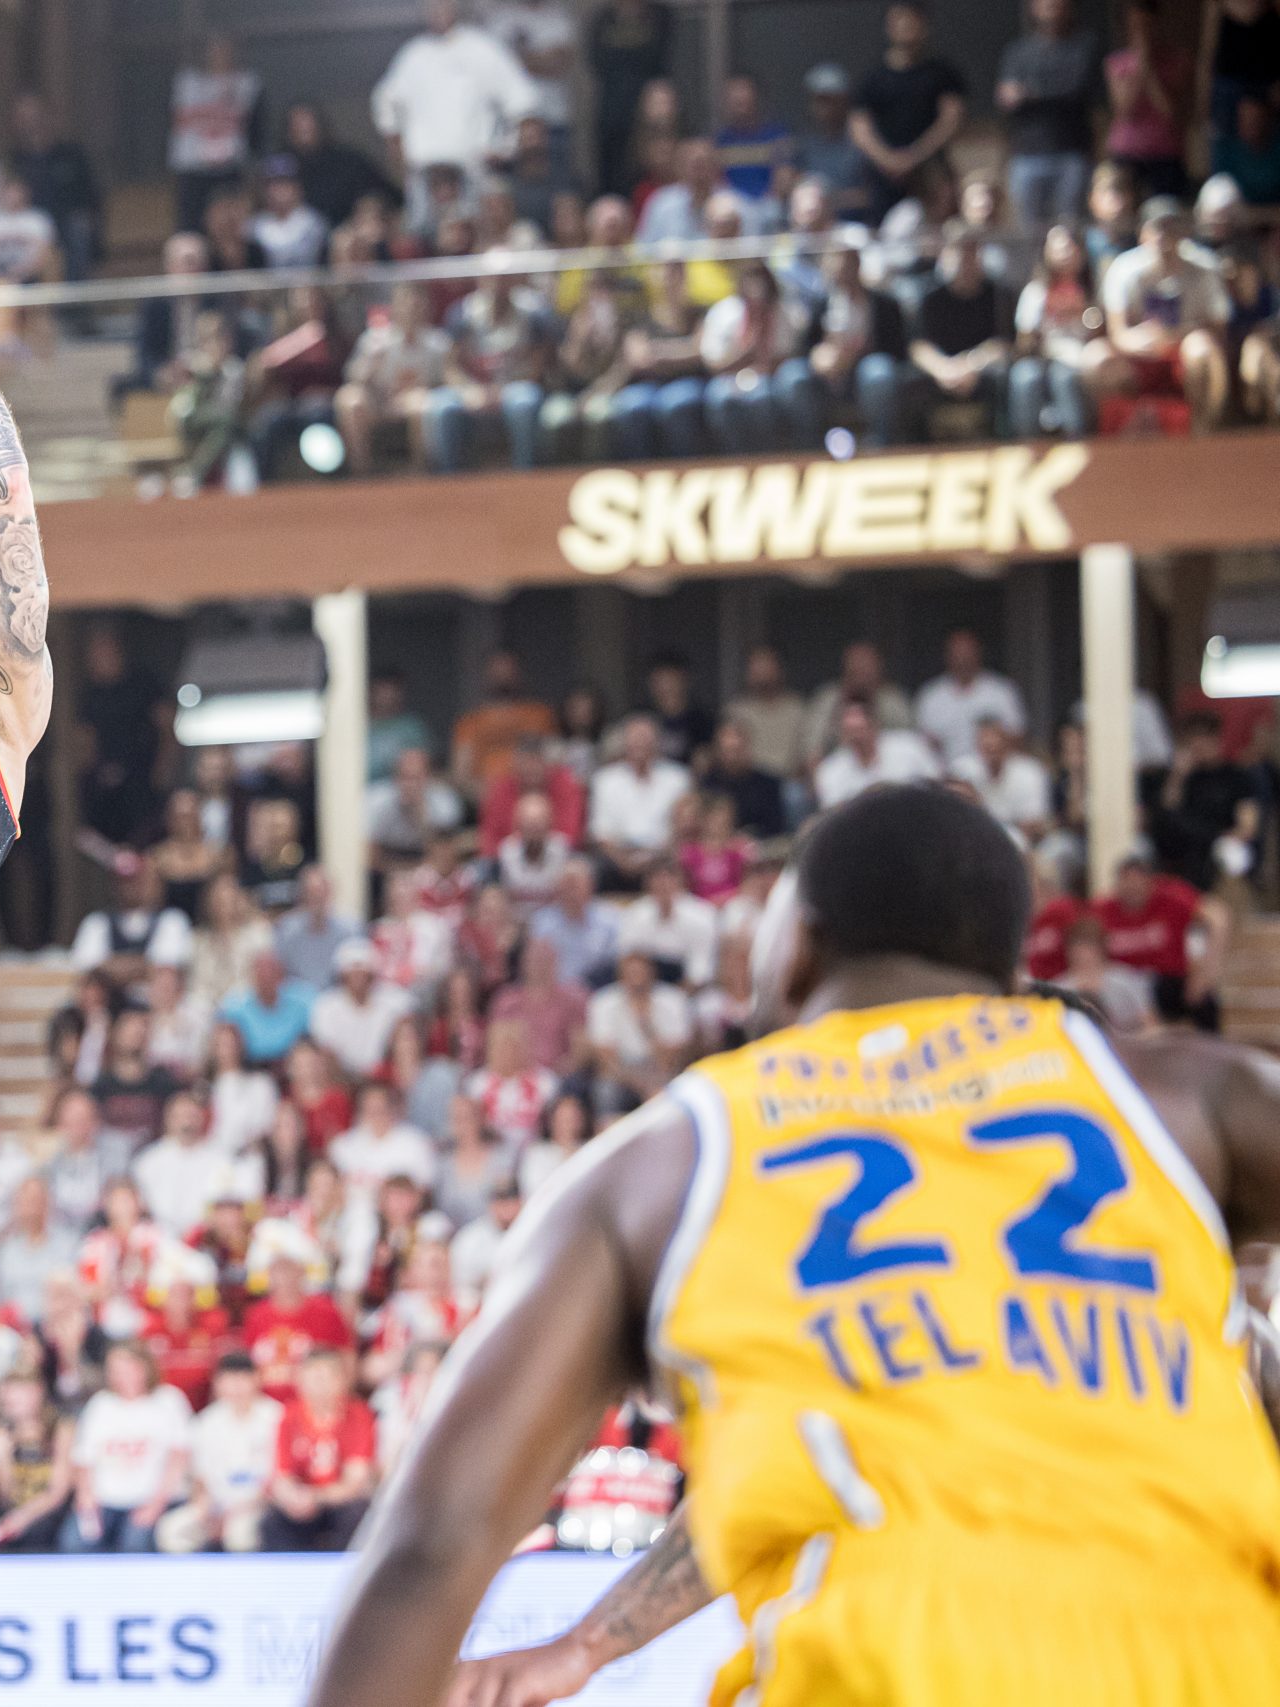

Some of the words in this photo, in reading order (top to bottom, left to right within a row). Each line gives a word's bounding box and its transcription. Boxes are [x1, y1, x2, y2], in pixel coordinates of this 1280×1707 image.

[558, 443, 1089, 574] SKWEEK
[760, 1108, 1158, 1293] 22
[808, 1294, 980, 1392] TEL
[1004, 1297, 1189, 1410] AVIV
[64, 1613, 220, 1683] LES
